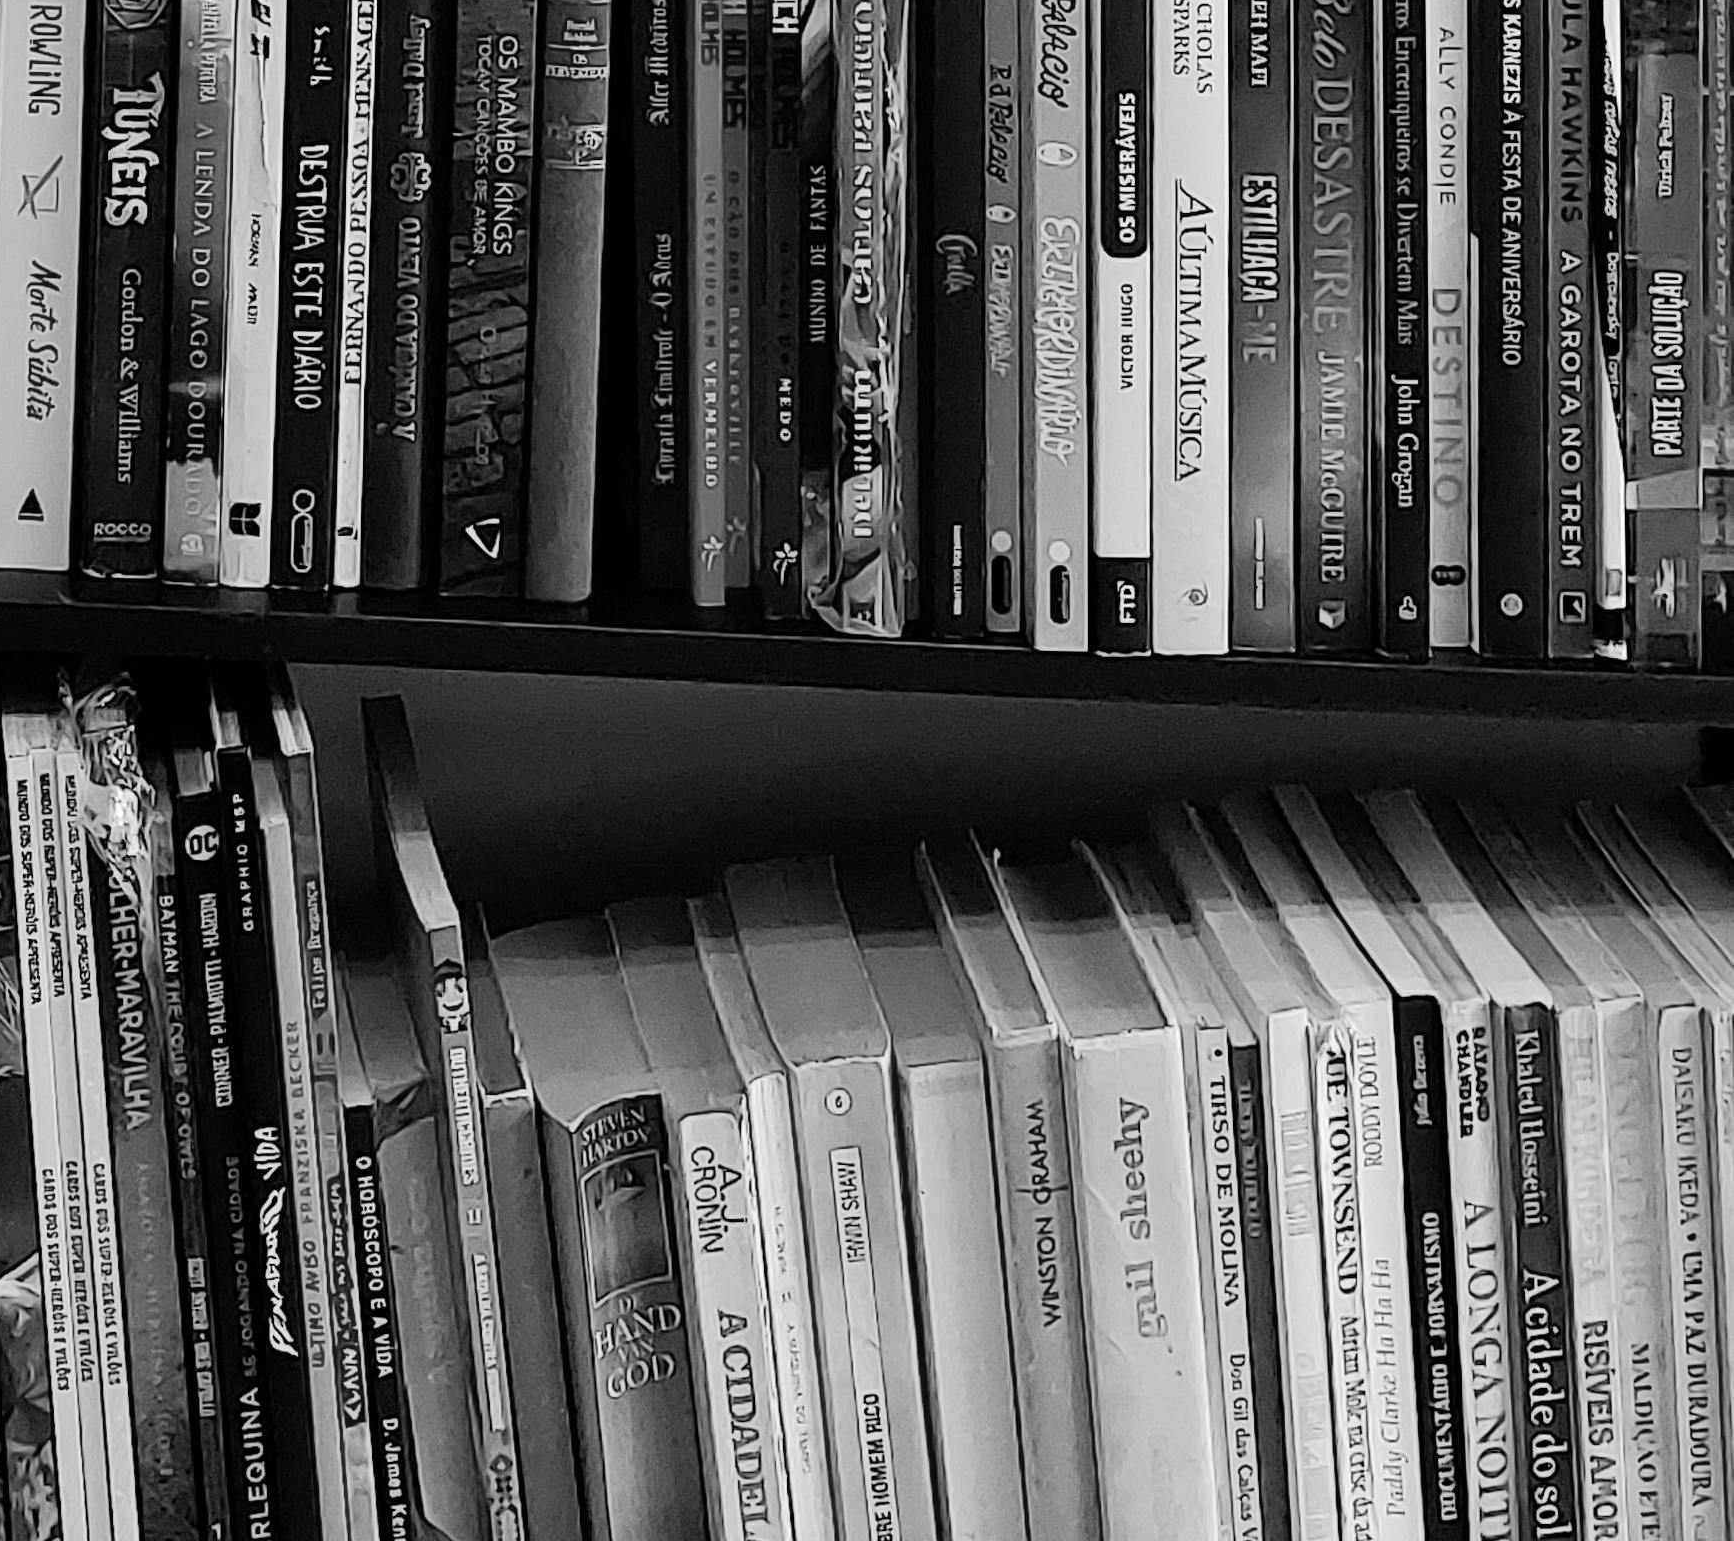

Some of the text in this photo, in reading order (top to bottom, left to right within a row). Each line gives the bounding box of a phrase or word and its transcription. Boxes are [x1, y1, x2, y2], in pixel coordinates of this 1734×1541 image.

[492, 36, 518, 255] OS MAMBO KINGS
[1502, 131, 1521, 190] FESTA
[1119, 216, 1135, 243] OS
[1503, 197, 1521, 224] DE
[293, 145, 329, 409] DESTRUA ESTE DIÁRIO
[1502, 228, 1524, 365] ANIVERSÁRIO
[118, 269, 143, 482] Gordon & Williams
[1433, 289, 1465, 508] DESTINO
[1561, 252, 1581, 565] A GAROTA NO TREM
[94, 523, 151, 541] ROCCO
[158, 895, 180, 973] BATMAN
[356, 1157, 371, 1169] O
[691, 1146, 721, 1253] CRONIN
[1027, 1100, 1061, 1326] WINSTON GRAHAM
[1210, 1076, 1238, 1307] TIRSO DE MOLINA
[371, 1298, 386, 1309] E
[373, 1317, 387, 1328] A
[375, 1335, 393, 1377] VIDA
[1524, 1270, 1572, 1538] A cidade do sol
